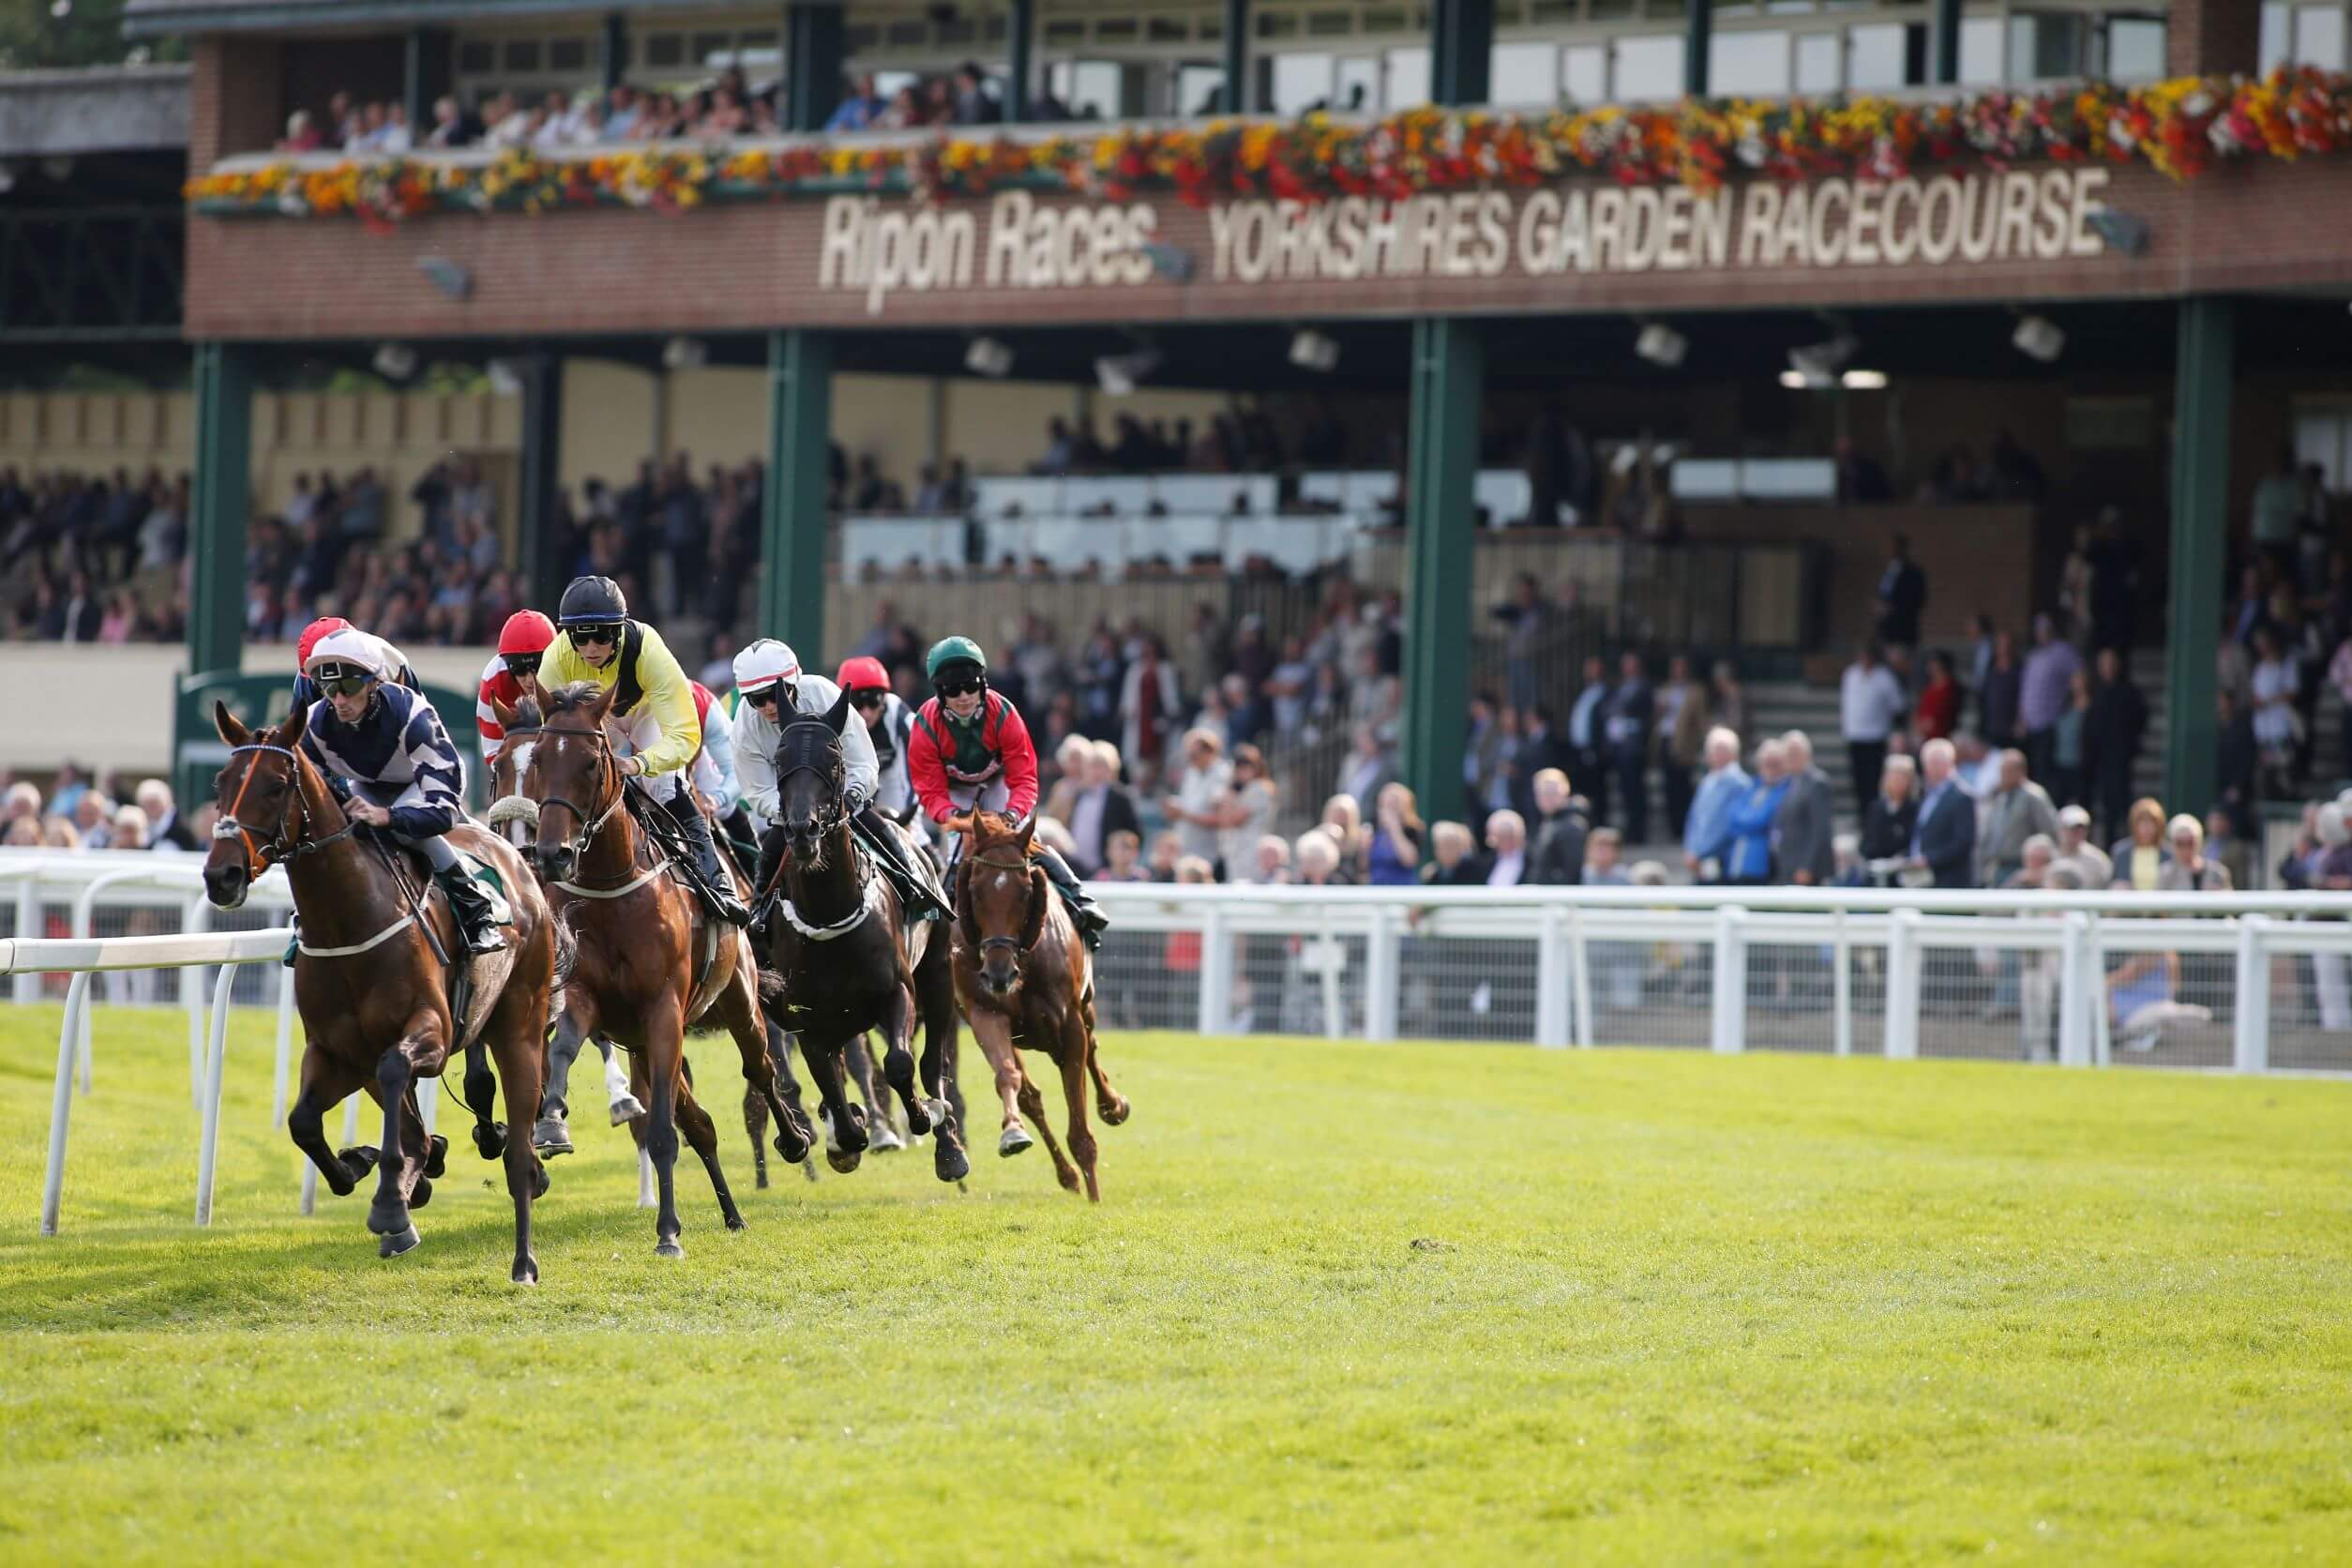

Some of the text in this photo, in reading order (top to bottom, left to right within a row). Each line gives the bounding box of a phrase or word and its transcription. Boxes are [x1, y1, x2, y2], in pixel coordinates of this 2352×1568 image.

[820, 189, 1157, 316] Ripon Races
[1518, 185, 1732, 276] GARDEN
[1739, 167, 2109, 268] RACECOURSE
